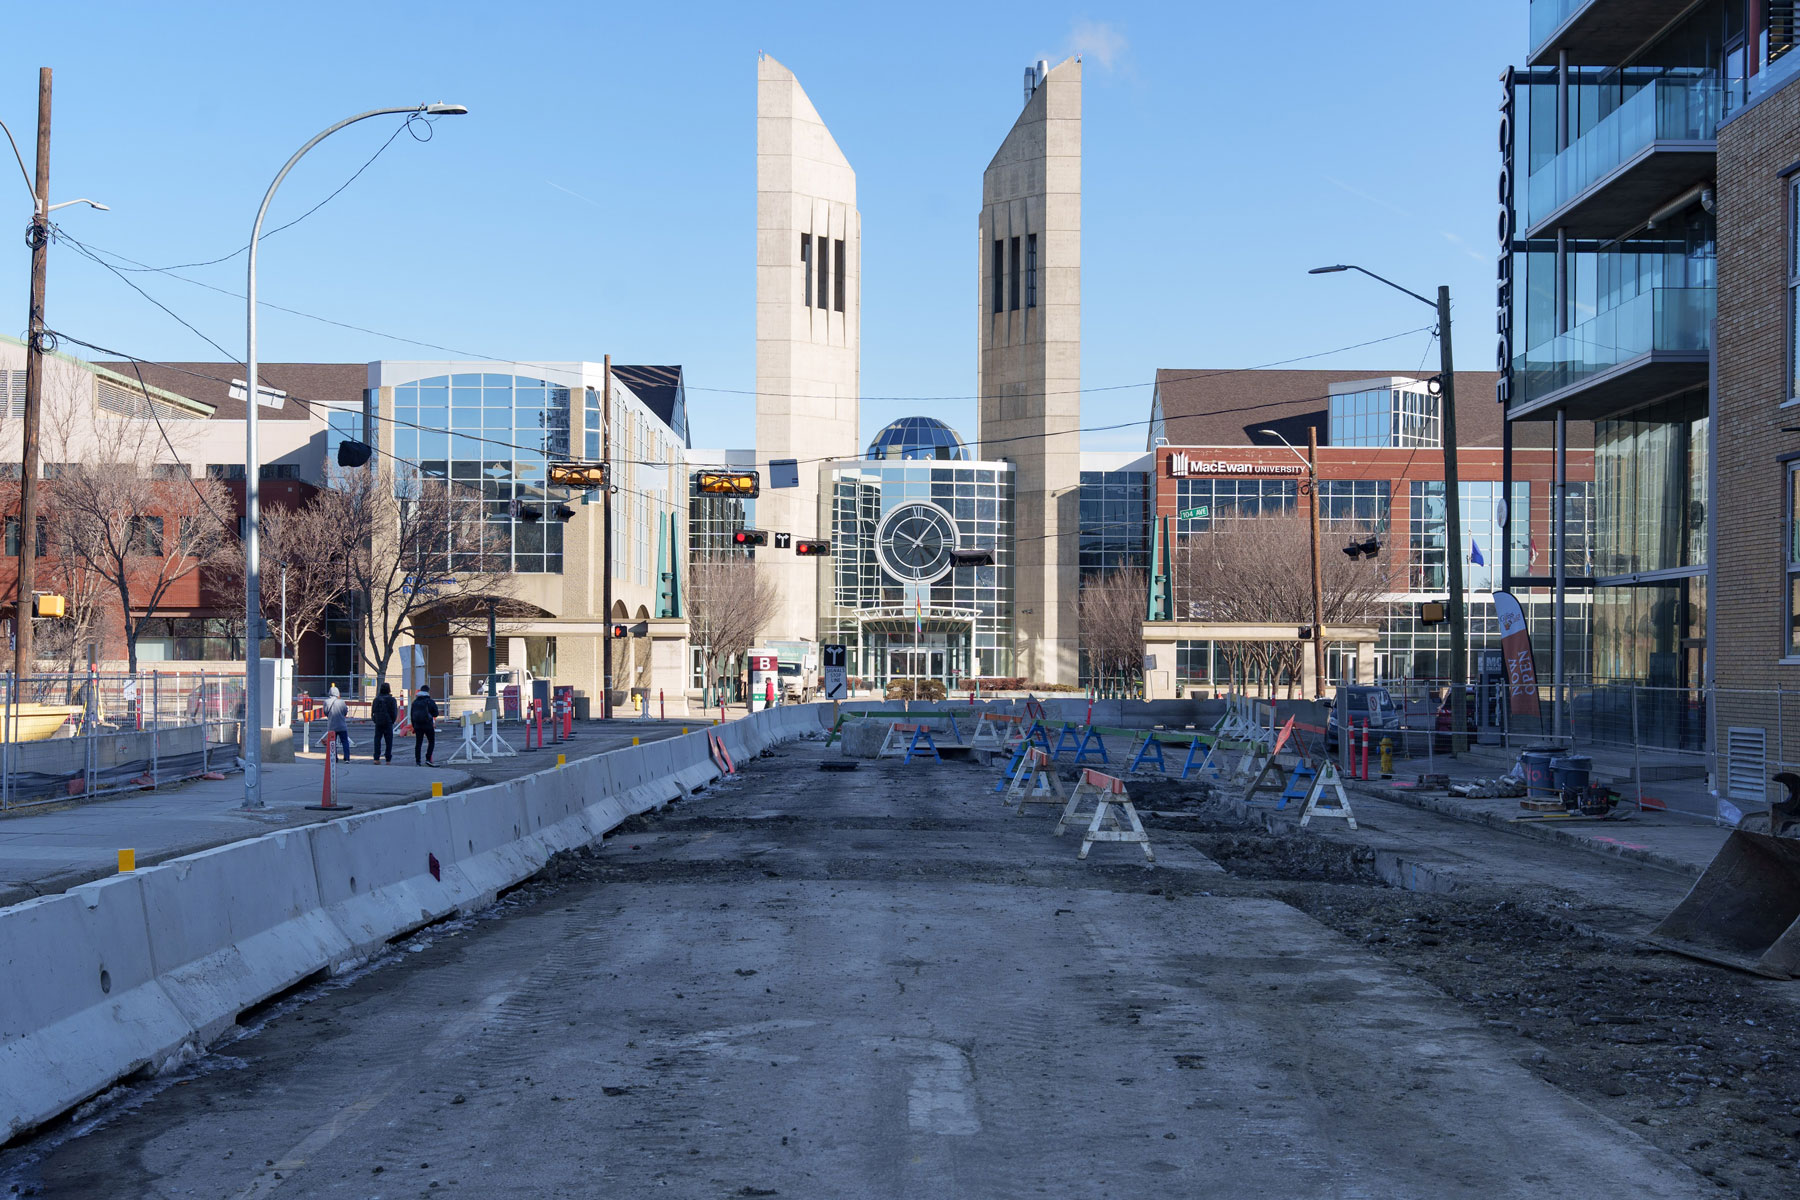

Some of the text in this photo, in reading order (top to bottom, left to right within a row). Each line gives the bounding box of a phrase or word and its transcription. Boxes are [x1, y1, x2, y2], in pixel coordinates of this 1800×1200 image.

[1190, 461, 1306, 473] MacEwan UNIVERSITY
[1182, 508, 1207, 519] 104 AVE
[760, 657, 770, 670] B
[1508, 659, 1523, 696] NOW
[1517, 650, 1536, 695] OPEN
